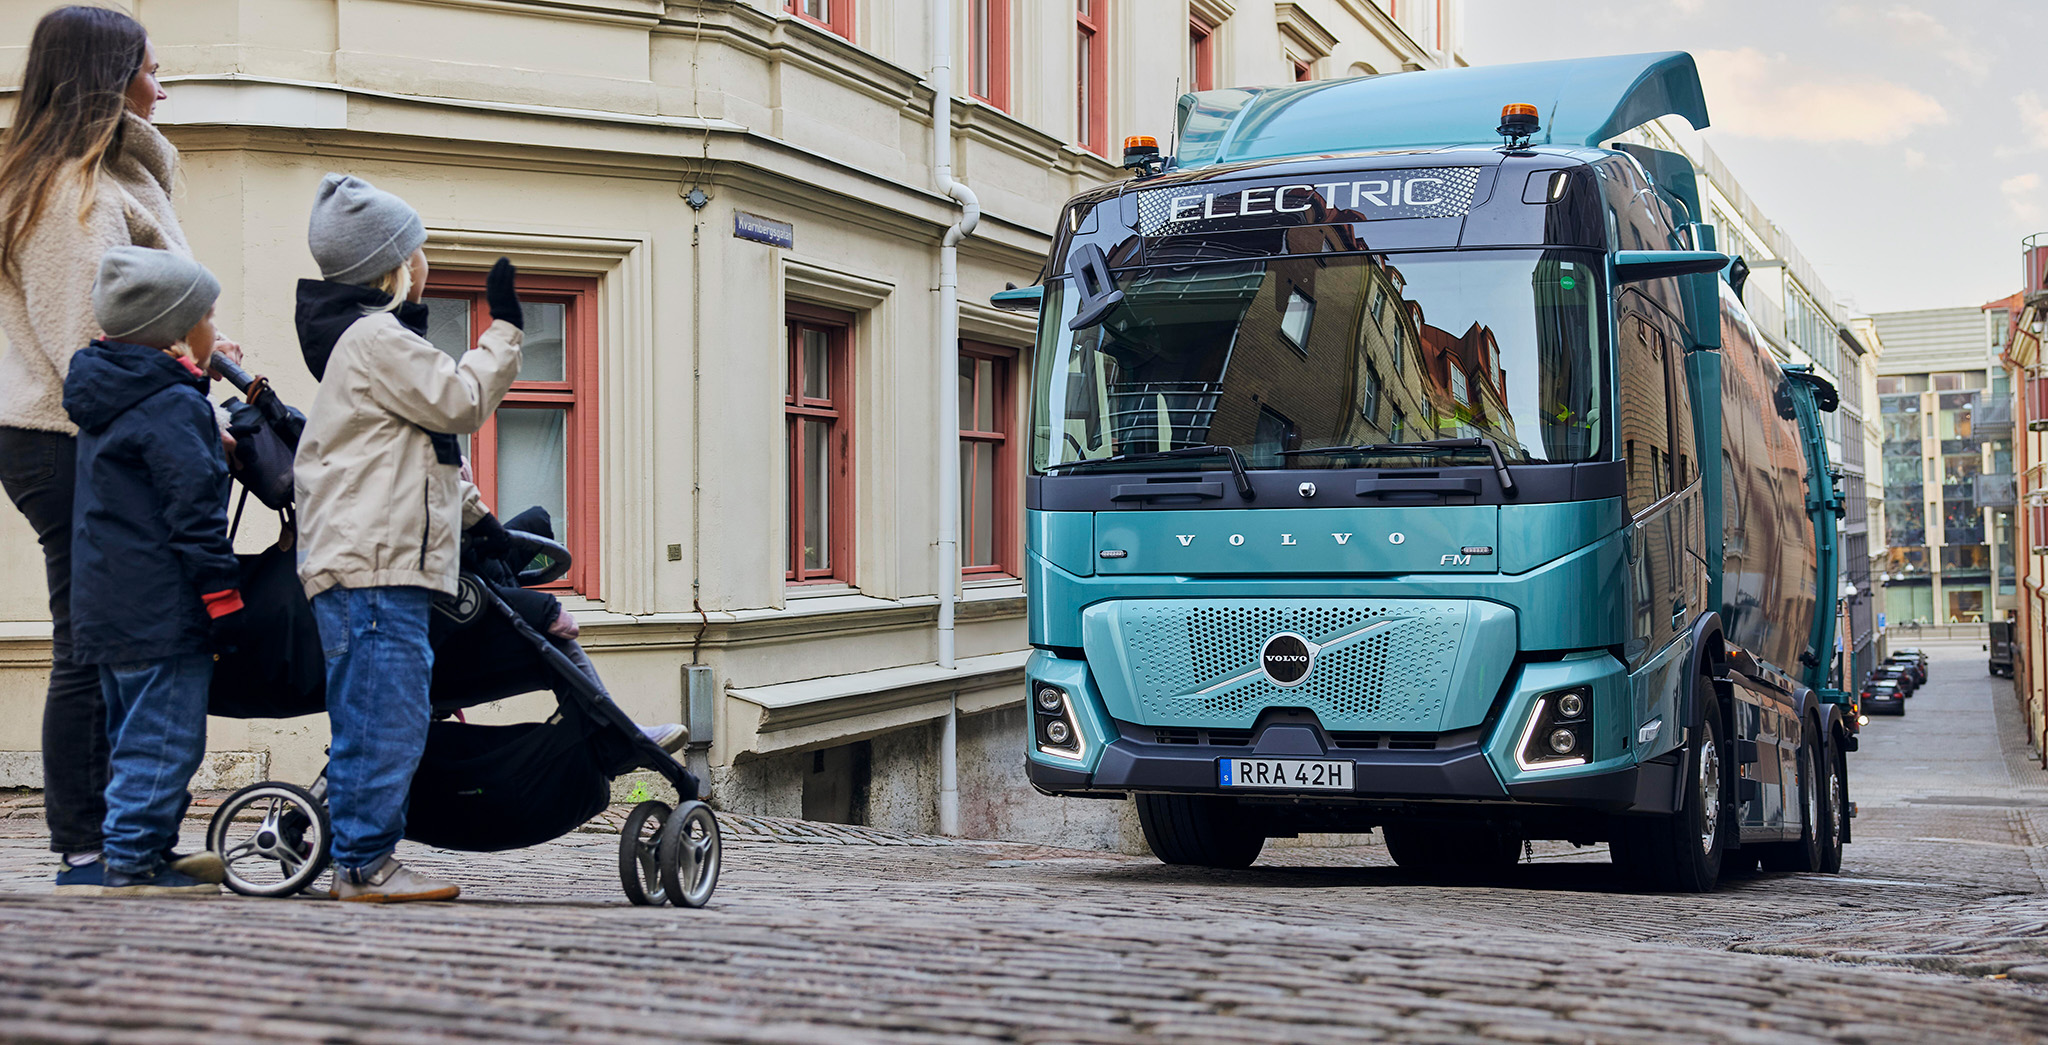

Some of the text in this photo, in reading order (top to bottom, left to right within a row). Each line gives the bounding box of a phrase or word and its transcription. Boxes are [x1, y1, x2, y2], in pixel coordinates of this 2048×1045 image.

[1169, 177, 1444, 223] ELECTRIC
[1175, 532, 1406, 546] VOLVO
[1440, 554, 1472, 566] FM
[1240, 761, 1342, 786] RRA 42H
